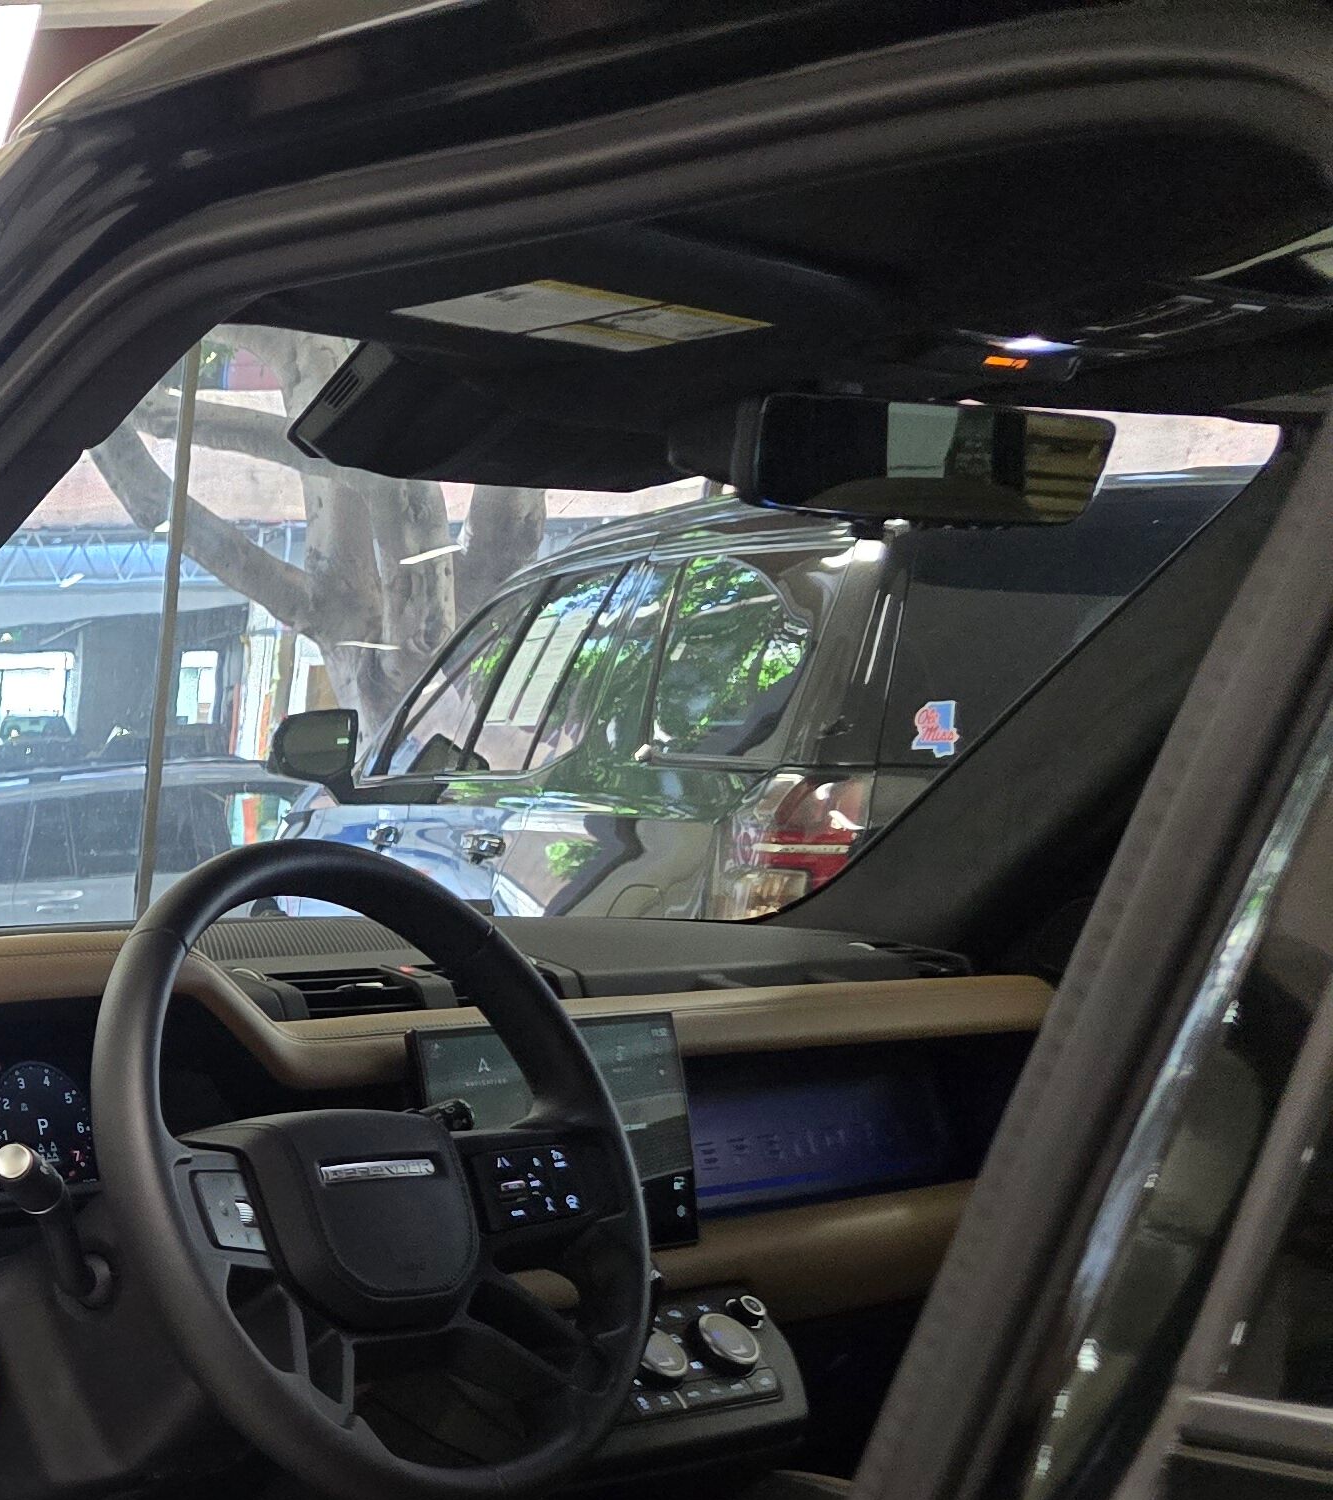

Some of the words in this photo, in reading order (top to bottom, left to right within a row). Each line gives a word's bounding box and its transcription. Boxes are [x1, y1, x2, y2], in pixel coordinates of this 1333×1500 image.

[17, 1078, 25, 1089] 3
[43, 1076, 50, 1087] 4
[64, 1092, 72, 1104] 5
[3, 1098, 10, 1110] 2
[37, 1118, 49, 1135] P
[77, 1122, 84, 1133] 6
[2, 1130, 8, 1140] 1
[73, 1150, 80, 1161] 7
